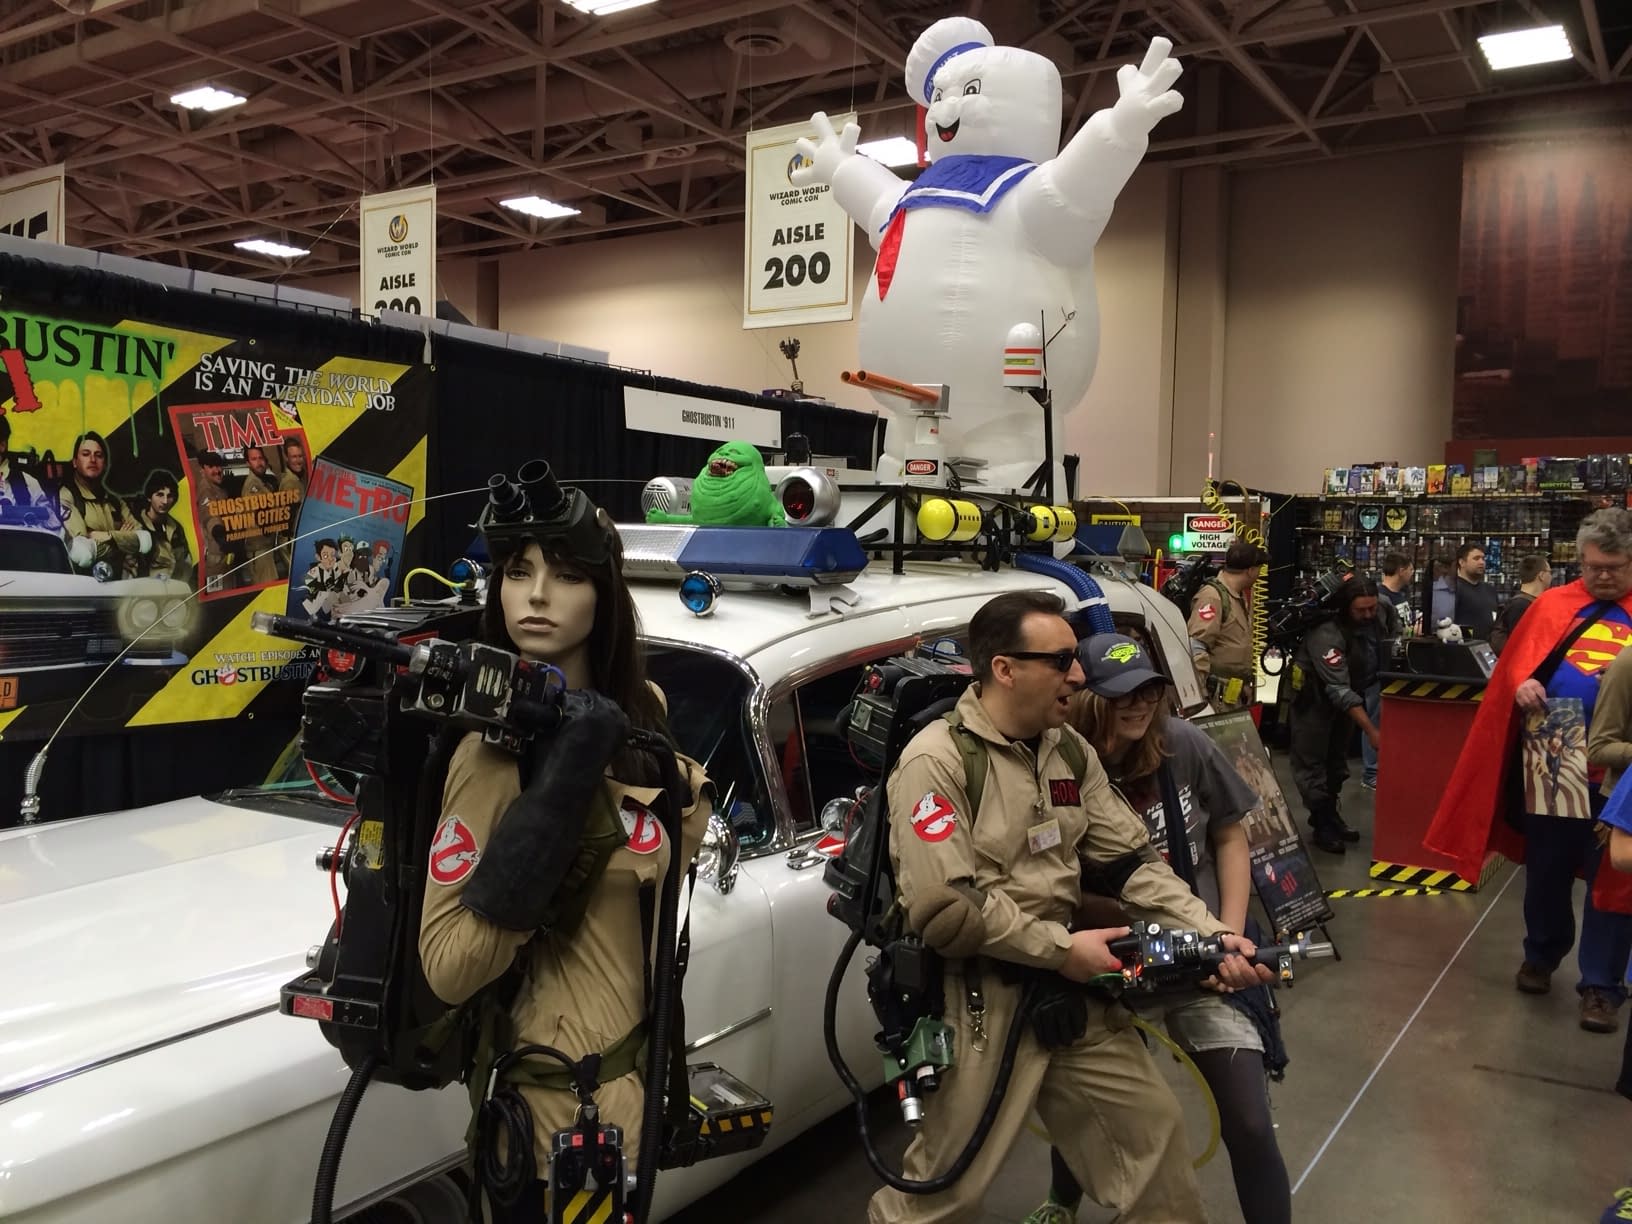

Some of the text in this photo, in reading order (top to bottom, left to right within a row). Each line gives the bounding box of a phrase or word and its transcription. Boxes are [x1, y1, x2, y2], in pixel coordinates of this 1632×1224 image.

[769, 185, 830, 201] WIZARD WORLD
[781, 194, 819, 206] COMIC CON
[771, 222, 825, 246] AISLE
[377, 242, 419, 254] WIZARD WORLD
[763, 251, 831, 290] 200
[379, 272, 416, 291] AISLE
[199, 353, 392, 394] SAVING THE WORLD
[194, 371, 396, 412] IS AN EVERYDAY JOB
[193, 411, 285, 452] TIME
[910, 463, 931, 471] DANGER
[208, 488, 300, 517] GHOSTBUSTERS
[306, 466, 410, 525] METRO
[221, 511, 256, 532] TWIN
[257, 505, 291, 526] CITIES
[1192, 520, 1227, 528] DANGER
[1191, 541, 1227, 549] VOLTAGE
[1199, 533, 1221, 541] HIGH
[214, 651, 256, 663] WATCH
[260, 649, 307, 661] EPISODES
